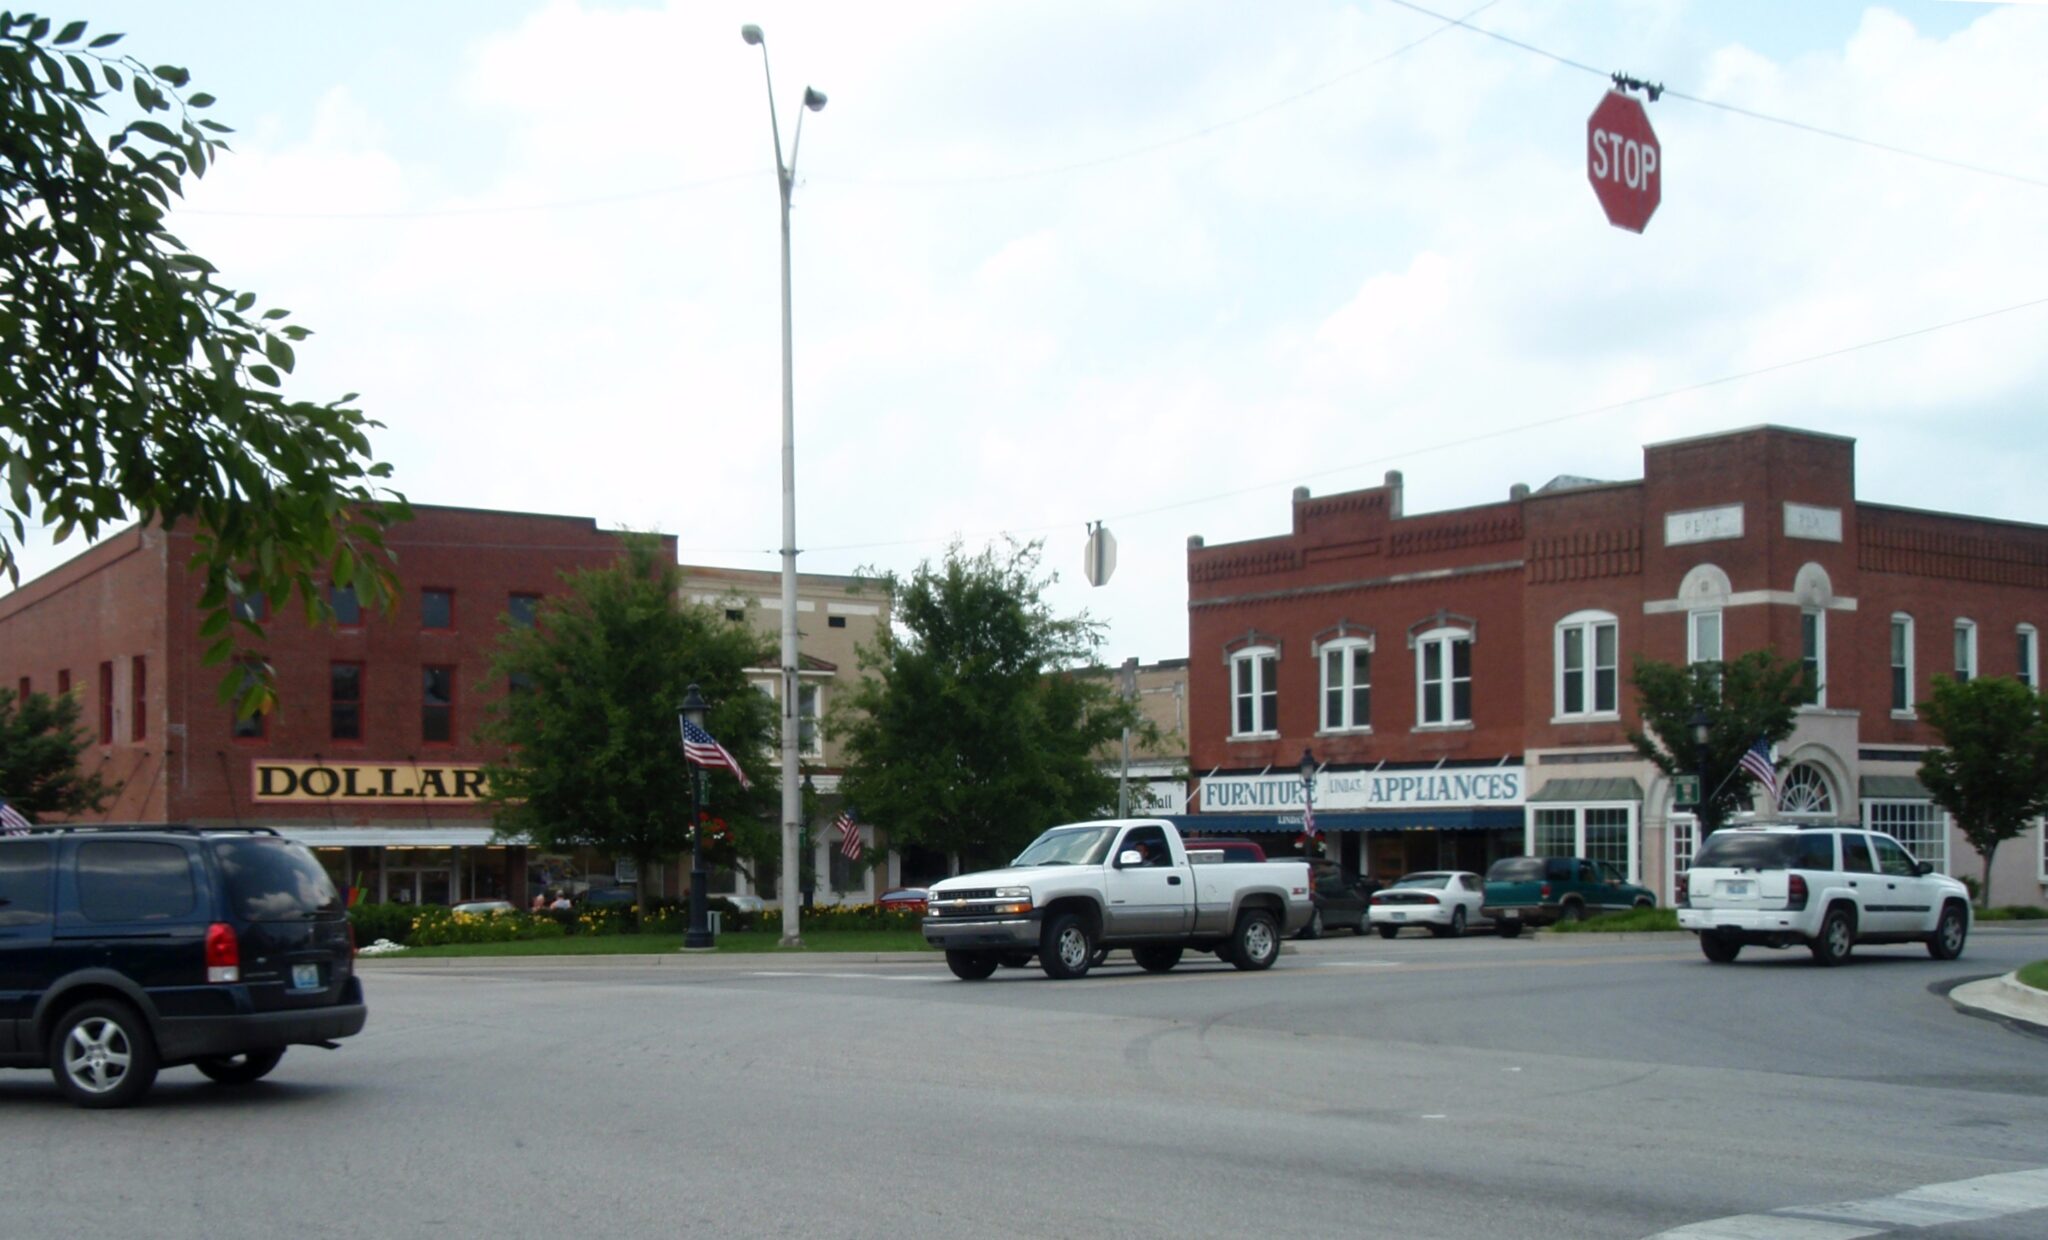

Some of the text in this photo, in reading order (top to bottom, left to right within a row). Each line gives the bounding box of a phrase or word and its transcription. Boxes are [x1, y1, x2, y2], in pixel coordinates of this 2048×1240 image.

[1593, 128, 1656, 191] STOP
[257, 767, 488, 797] DOLLAR
[1206, 779, 1318, 806] FURNITURE
[1370, 773, 1518, 802] APPLIANCES
